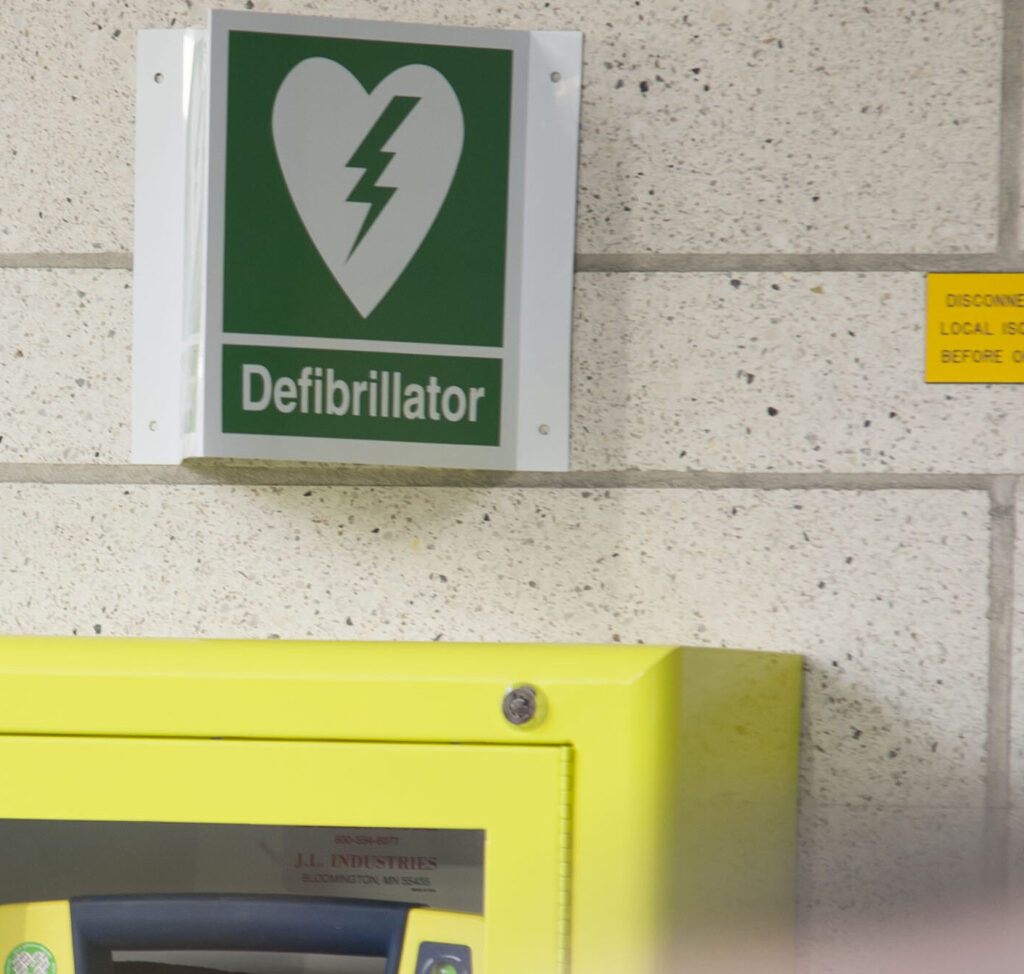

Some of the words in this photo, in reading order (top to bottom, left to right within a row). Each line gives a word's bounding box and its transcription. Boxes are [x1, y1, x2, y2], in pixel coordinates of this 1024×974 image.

[940, 321, 994, 336] LOCAL
[940, 349, 1003, 364] BEFORE
[242, 363, 485, 422] Defibrillator
[330, 853, 438, 871] INDUSTRIES
